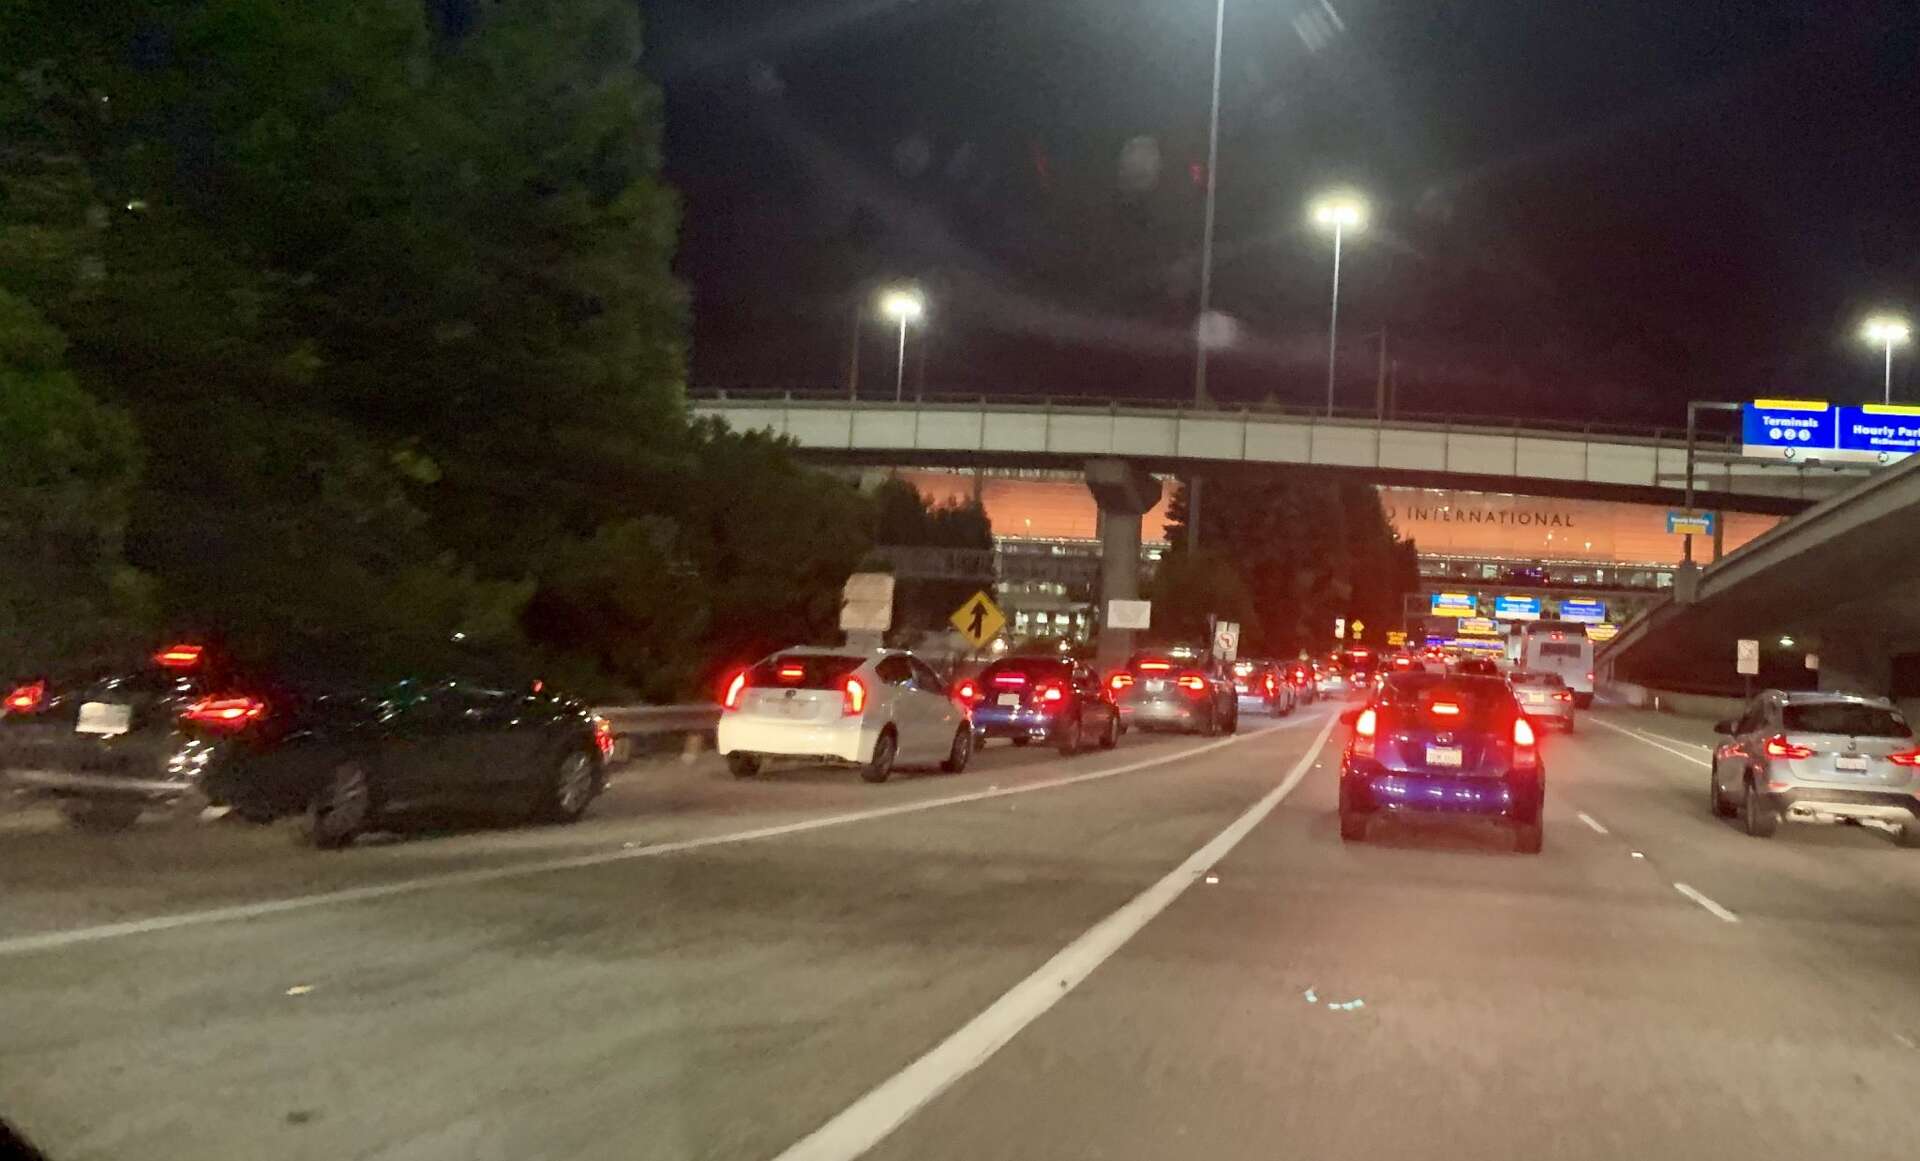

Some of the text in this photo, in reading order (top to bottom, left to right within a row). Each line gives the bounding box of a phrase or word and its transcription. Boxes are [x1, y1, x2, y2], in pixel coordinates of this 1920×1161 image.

[1762, 415, 1819, 428] Terminals
[1853, 424, 1895, 439] Hourly
[1406, 505, 1575, 528] INTERNATIONAL
